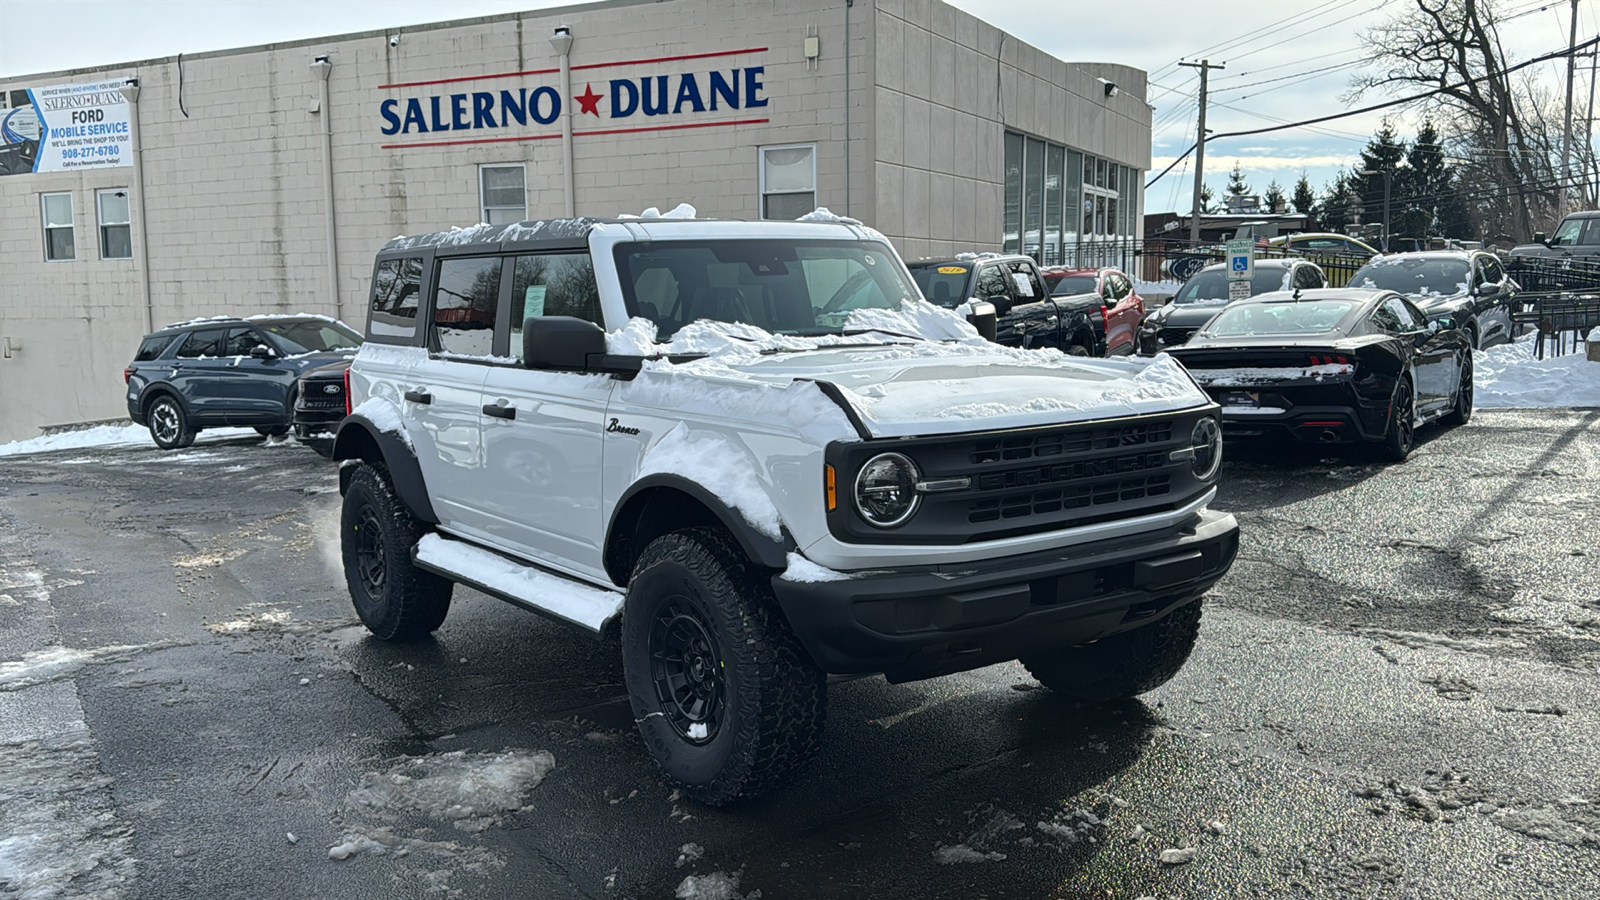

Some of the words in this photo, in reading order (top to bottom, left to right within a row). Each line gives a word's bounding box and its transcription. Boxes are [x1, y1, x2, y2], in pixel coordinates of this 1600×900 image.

[42, 88, 58, 96] SERVICE
[71, 86, 82, 94] (AND
[82, 84, 99, 92] WHERE)
[44, 95, 86, 110] SALERNO
[90, 91, 125, 105] DUANE
[380, 85, 562, 135] SALERNO
[609, 66, 769, 119] DUANE
[72, 109, 104, 124] FORD
[51, 125, 87, 139] MOBILE
[88, 121, 128, 136] SERVICE
[93, 136, 107, 144] SHOP
[62, 145, 119, 159] 908-277-6780
[81, 158, 106, 166] Reservation
[606, 417, 641, 436] Bronco
[979, 453, 1166, 491] BRONCO
